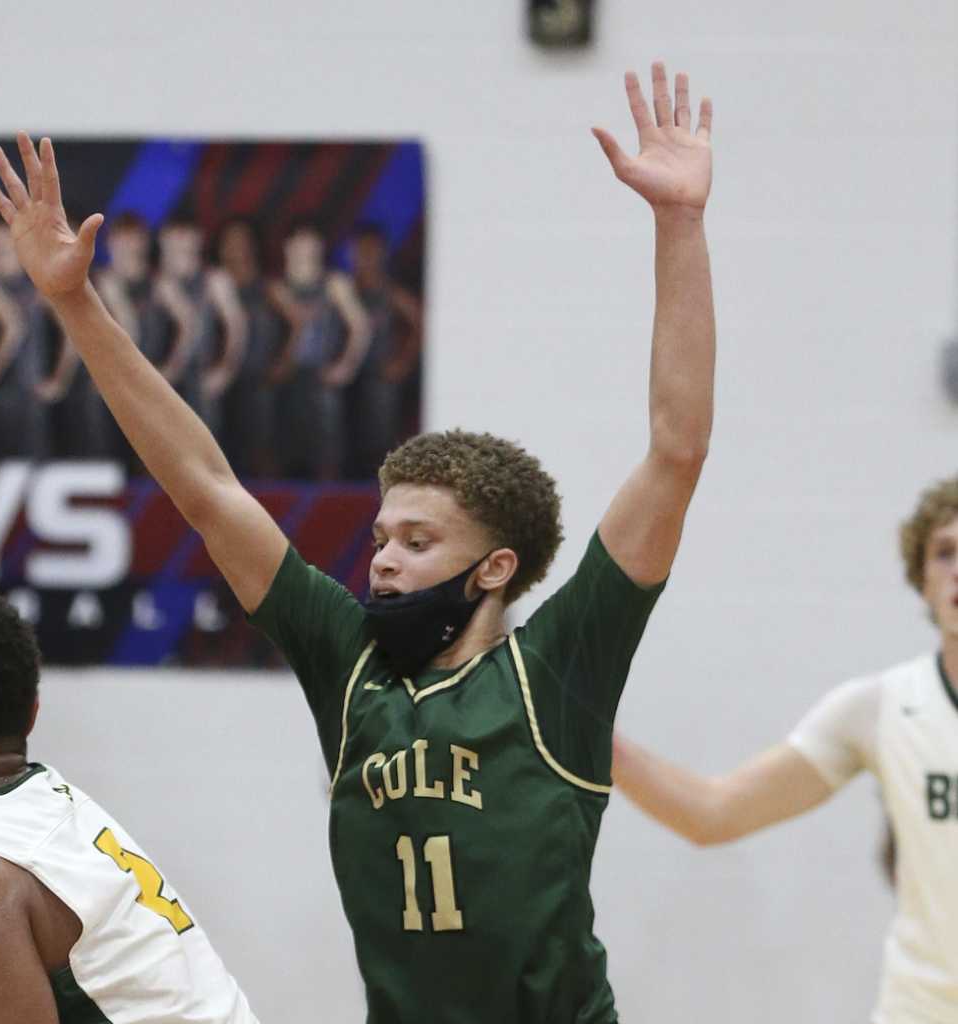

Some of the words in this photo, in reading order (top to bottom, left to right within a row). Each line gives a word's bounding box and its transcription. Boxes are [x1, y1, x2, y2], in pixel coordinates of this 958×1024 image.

[362, 739, 483, 810] COLE
[926, 772, 958, 821] B
[396, 835, 463, 931] 11
